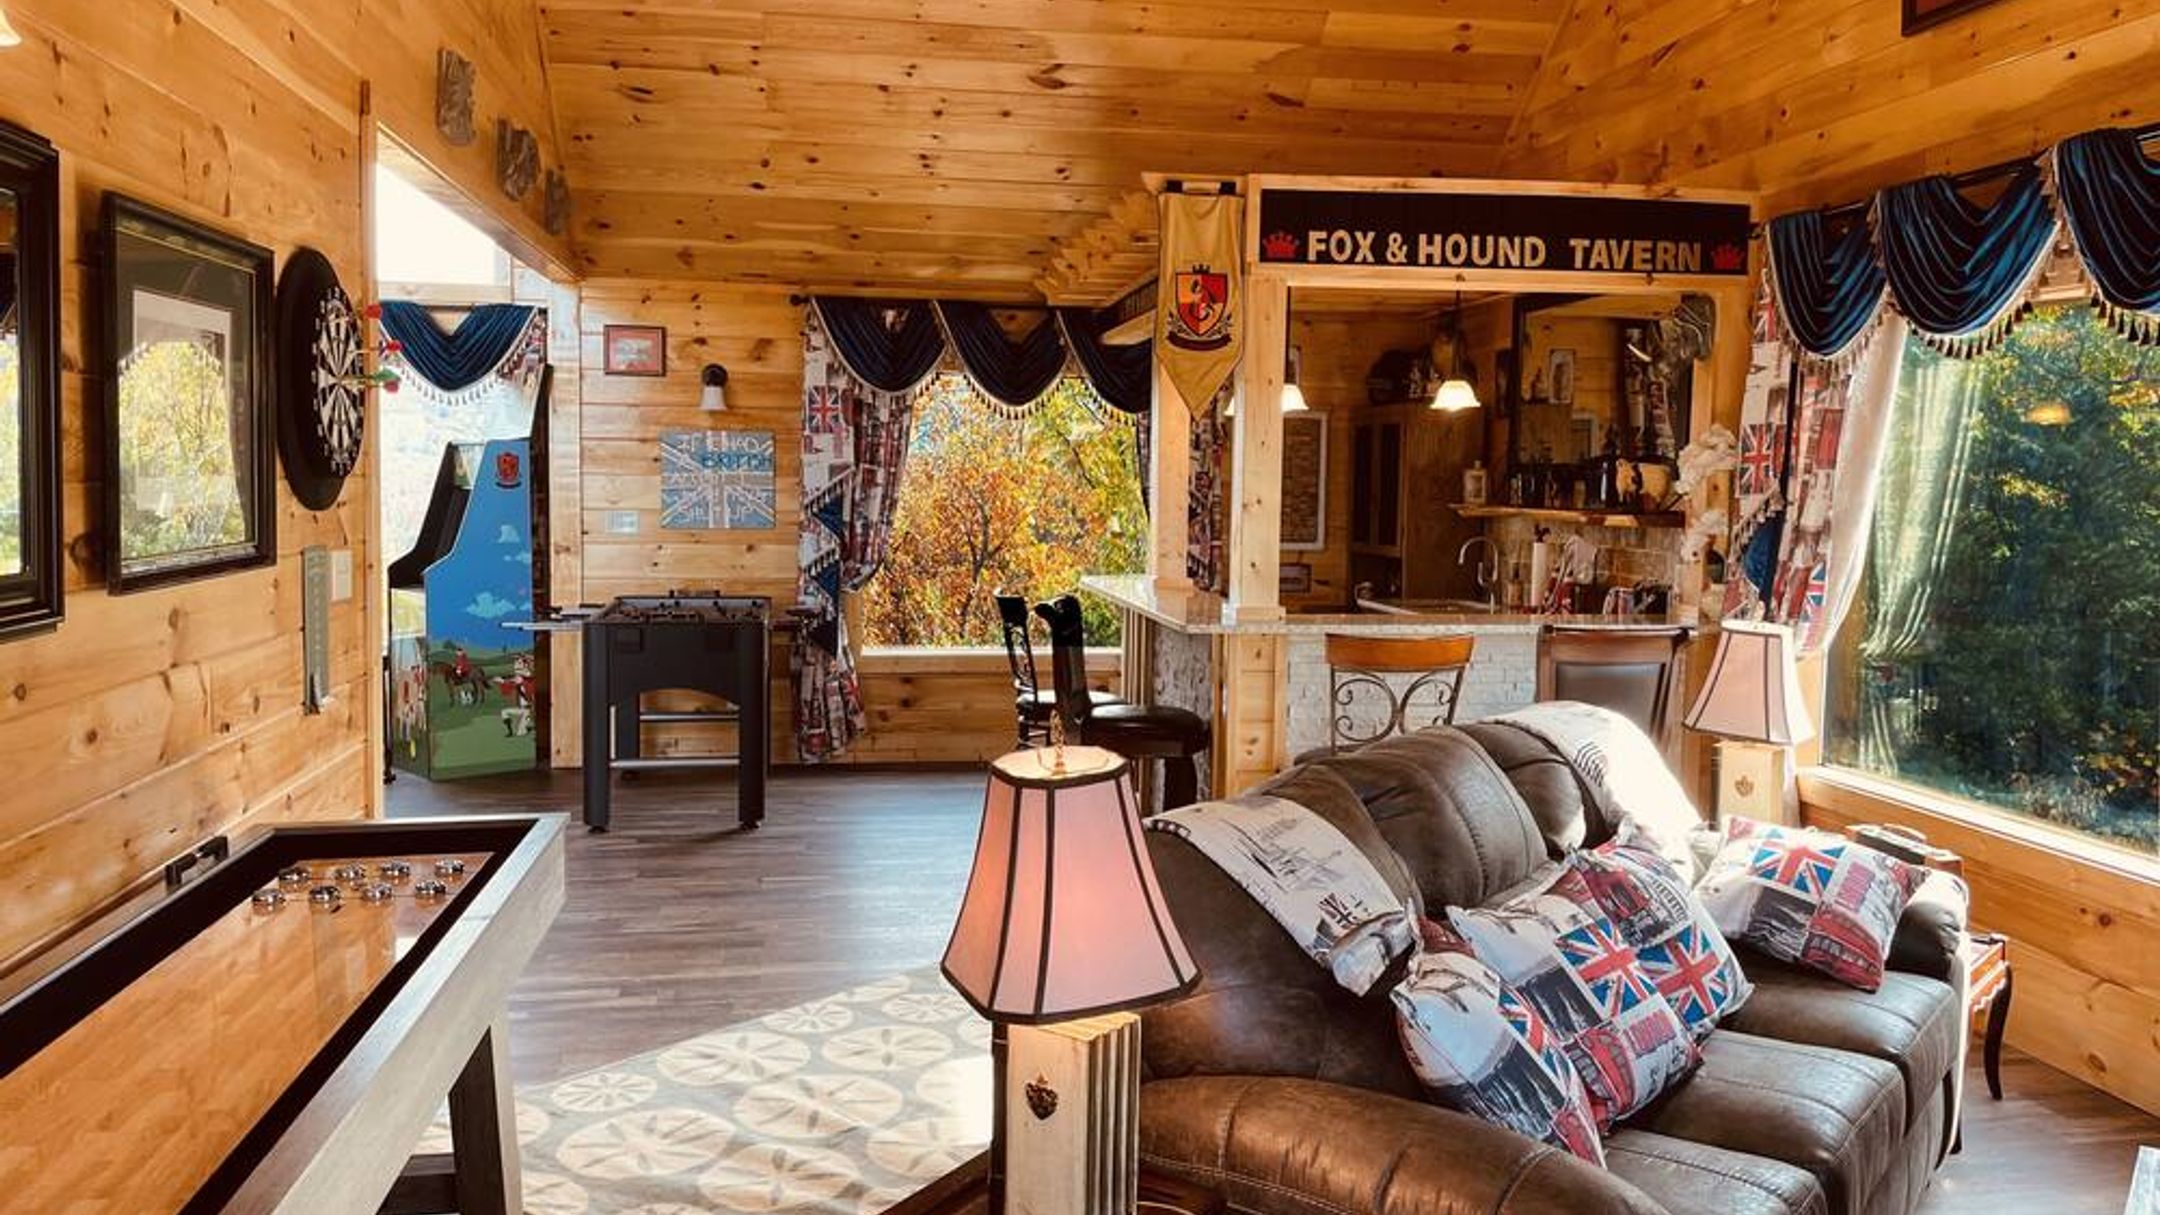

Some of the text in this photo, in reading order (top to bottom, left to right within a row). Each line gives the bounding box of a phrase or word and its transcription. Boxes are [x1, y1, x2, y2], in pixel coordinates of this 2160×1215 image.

[1307, 229, 1701, 271] FOX & HOUND TAVERN
